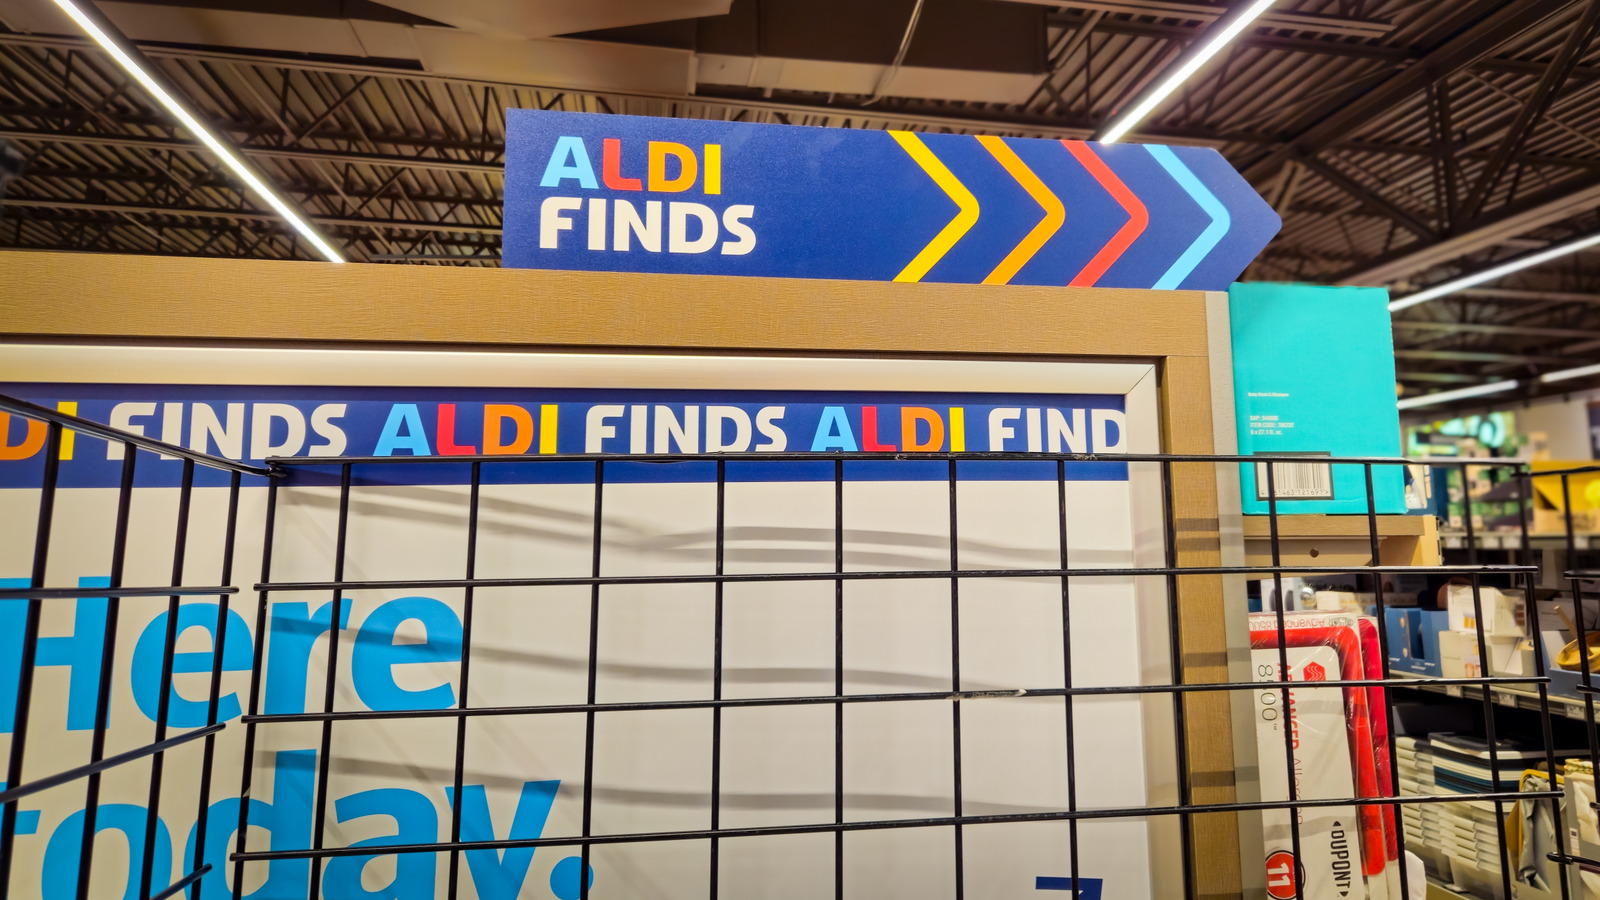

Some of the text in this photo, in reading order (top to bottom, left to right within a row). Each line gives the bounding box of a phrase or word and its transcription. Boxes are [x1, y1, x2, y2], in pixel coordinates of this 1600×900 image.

[539, 136, 721, 195] ALDI
[539, 196, 757, 256] FINDS
[106, 402, 347, 461] FINDS
[373, 403, 558, 456] ALDI
[584, 405, 788, 454] FINDS
[810, 406, 965, 453] ALDI
[988, 407, 1127, 454] FIND
[0, 576, 465, 734] Here
[1258, 664, 1278, 721] 800
[1277, 663, 1304, 824] ADANCED Allrn
[1267, 862, 1291, 887] 11
[1330, 829, 1351, 889] DUPONT
